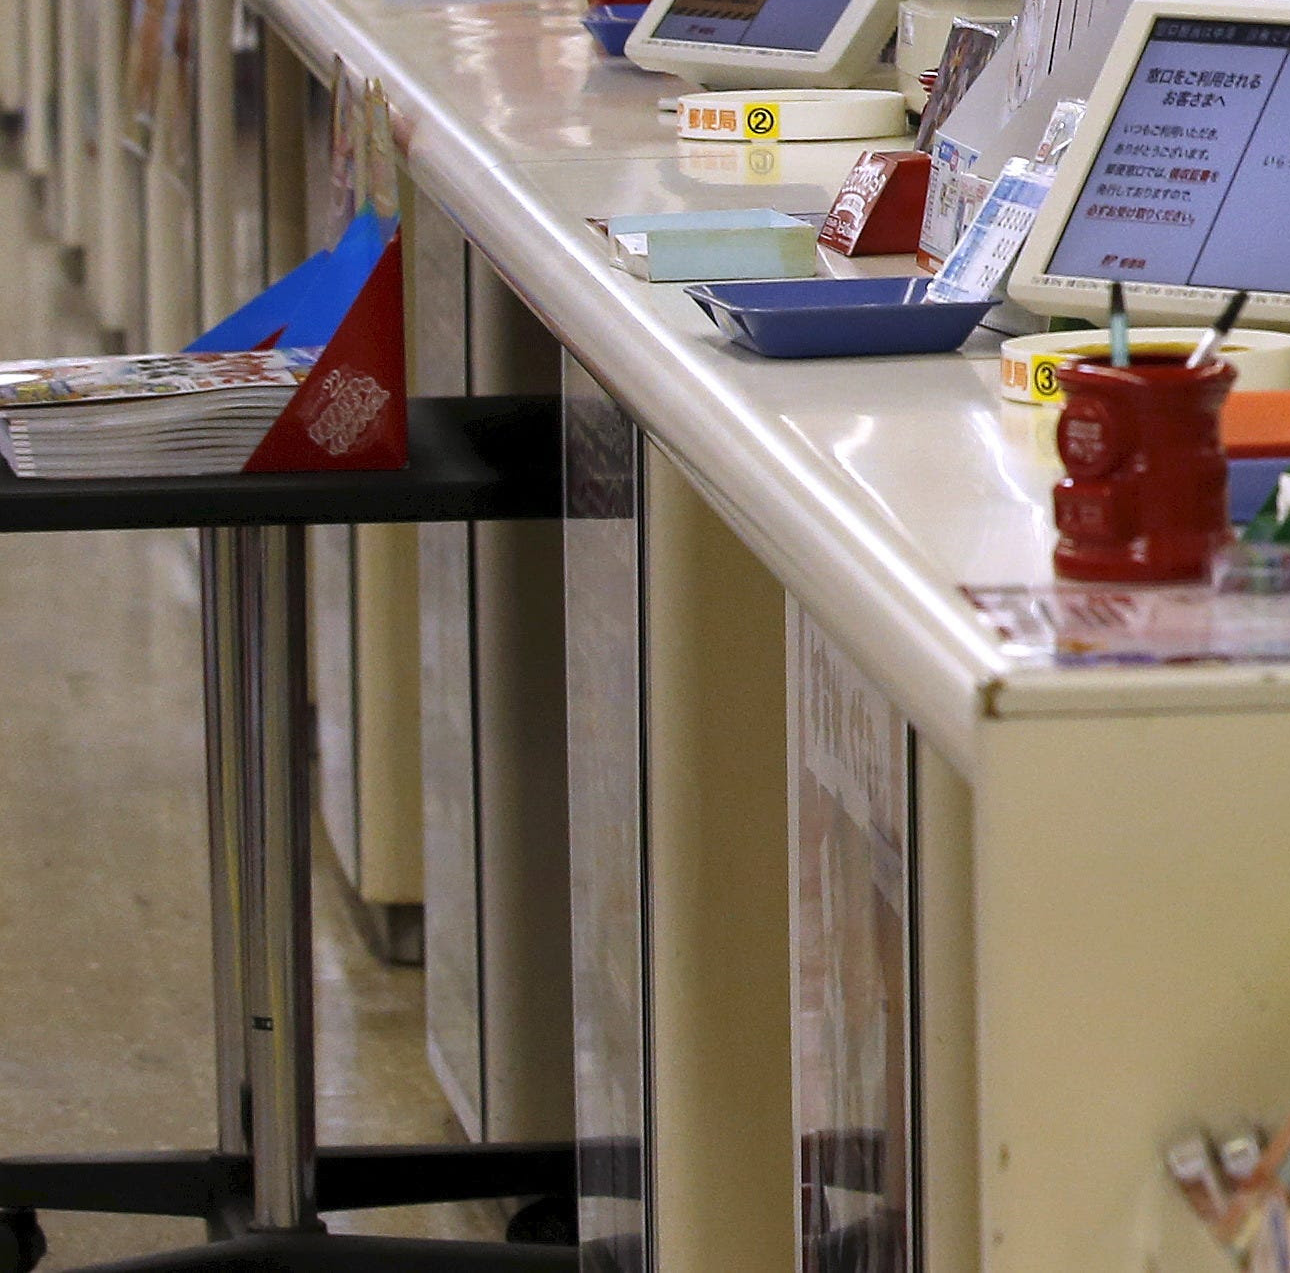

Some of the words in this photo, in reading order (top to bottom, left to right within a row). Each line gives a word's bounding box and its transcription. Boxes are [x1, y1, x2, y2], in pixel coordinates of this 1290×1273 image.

[1146, 67, 1263, 89] 窓口をご利用される
[1162, 89, 1226, 108] お客さまへ
[688, 107, 738, 133] 郵便局
